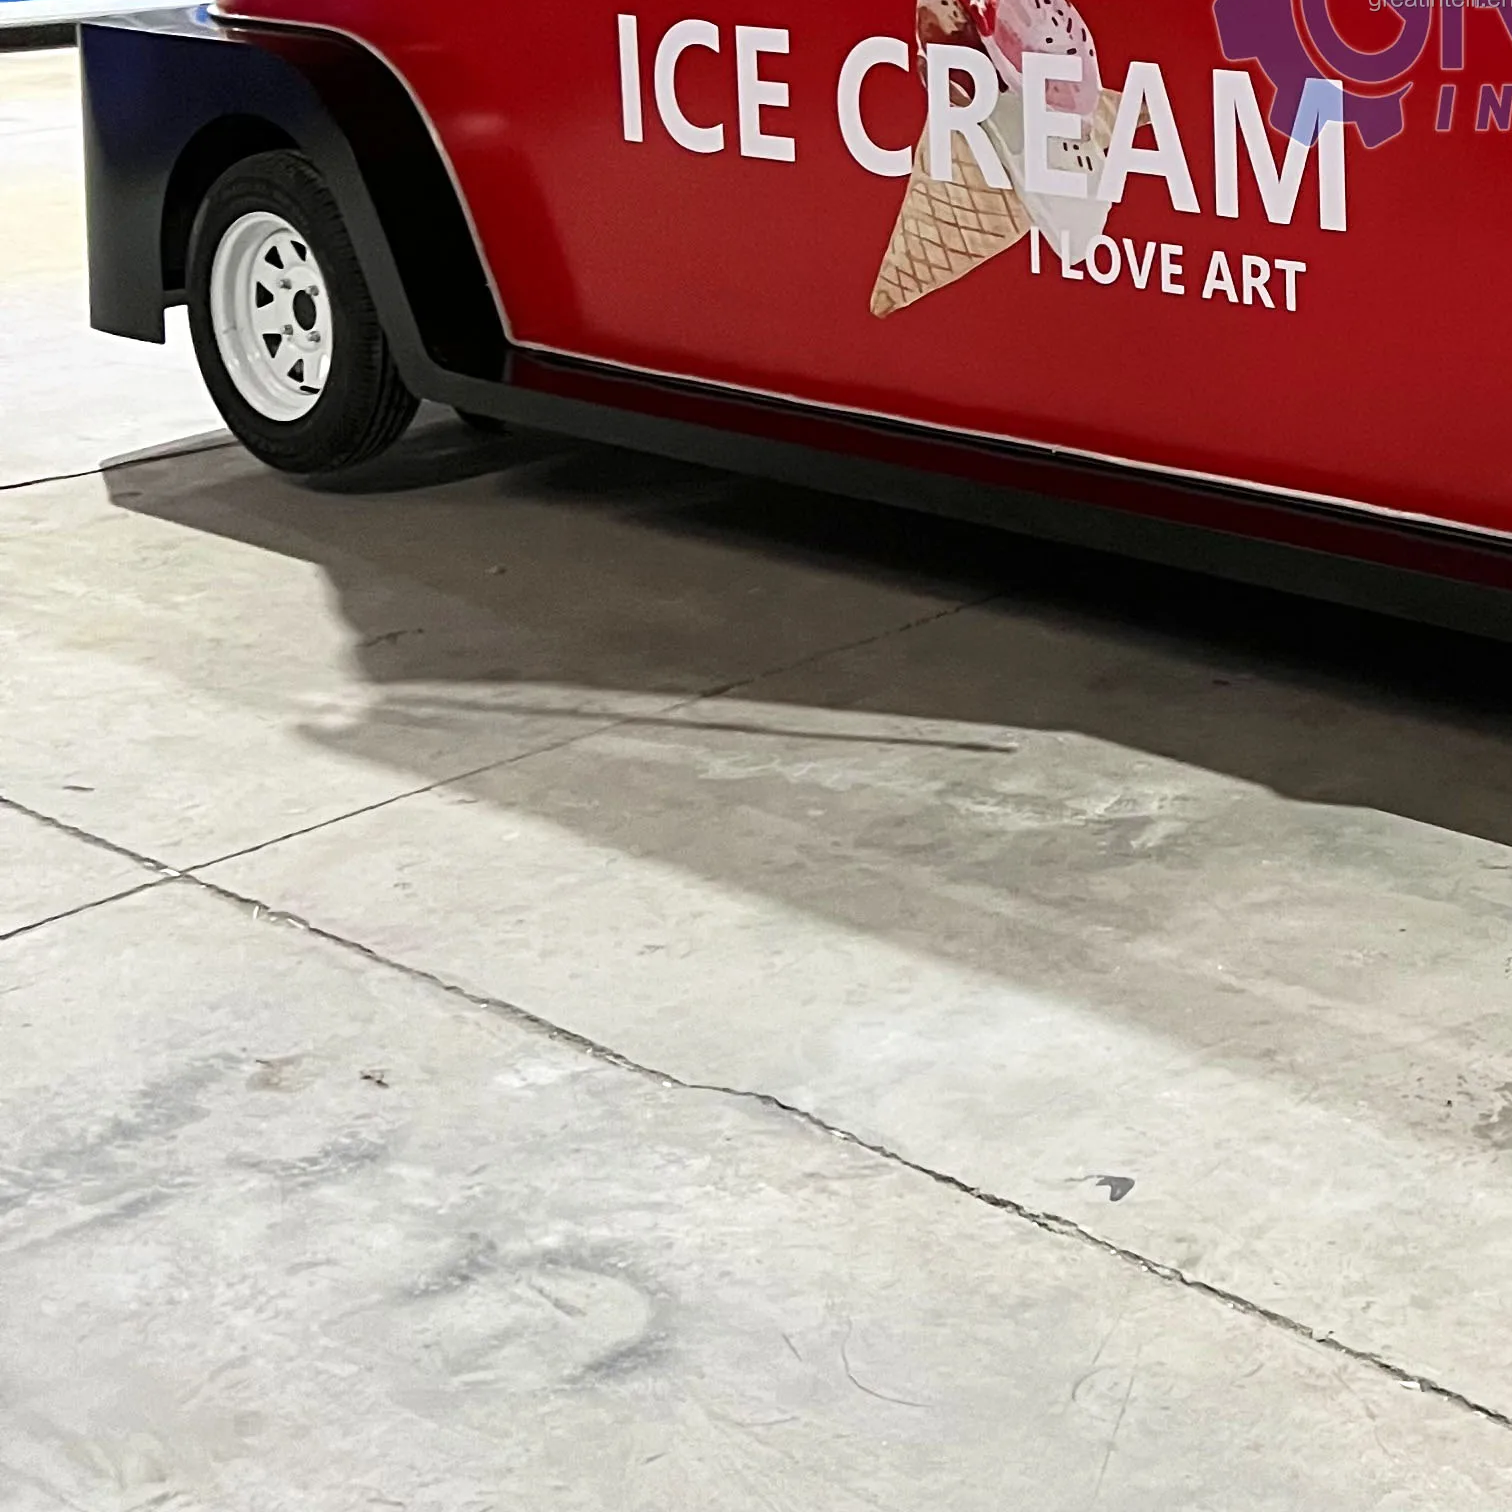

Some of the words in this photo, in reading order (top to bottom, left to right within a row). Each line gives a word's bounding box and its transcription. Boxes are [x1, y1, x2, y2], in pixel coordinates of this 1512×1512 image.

[617, 13, 796, 163] ICE
[836, 35, 1348, 233] CREAM
[1029, 225, 1041, 275] I
[1060, 231, 1185, 296] LOVE
[1201, 249, 1308, 313] ART
